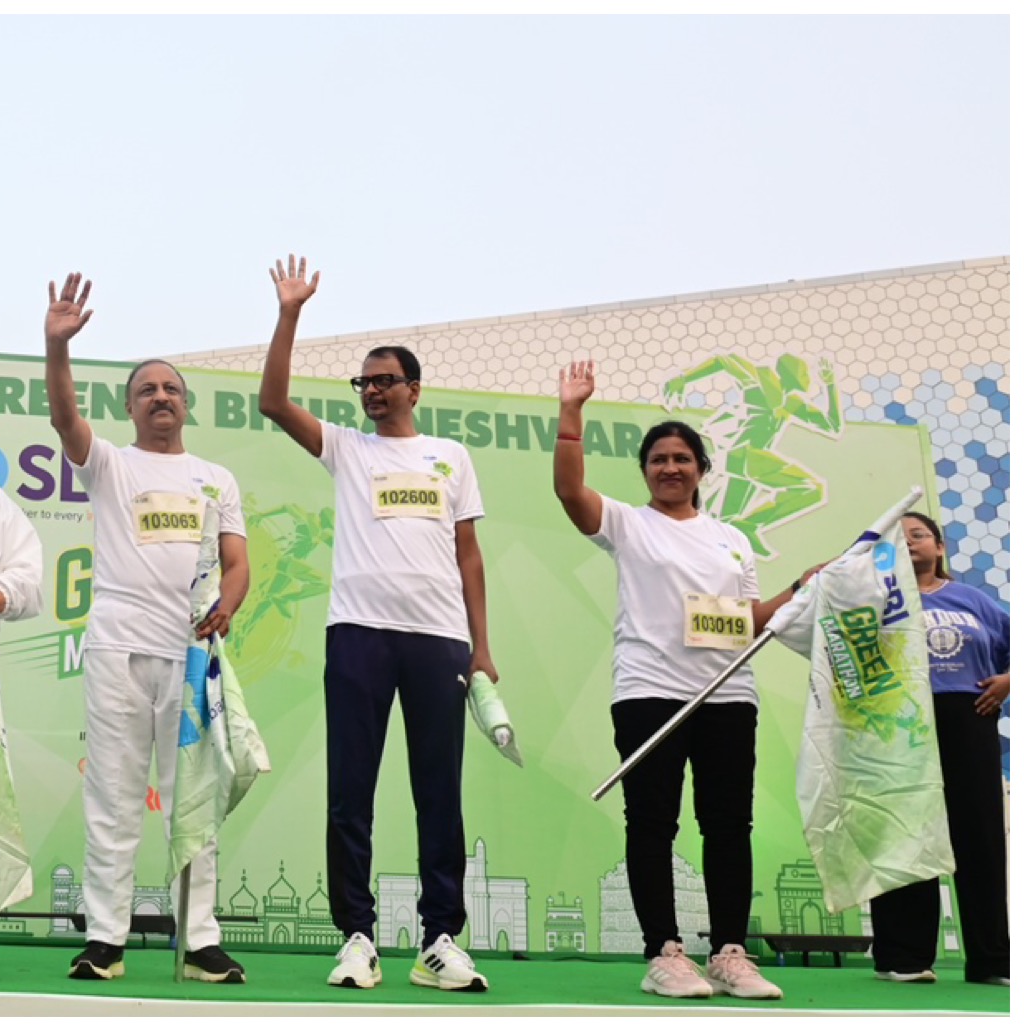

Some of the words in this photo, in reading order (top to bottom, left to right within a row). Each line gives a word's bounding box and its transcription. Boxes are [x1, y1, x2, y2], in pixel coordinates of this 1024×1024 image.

[214, 390, 644, 458] BHBNESHWAR
[380, 490, 438, 505] 102600
[141, 512, 199, 531] 103063
[692, 613, 745, 635] 103019
